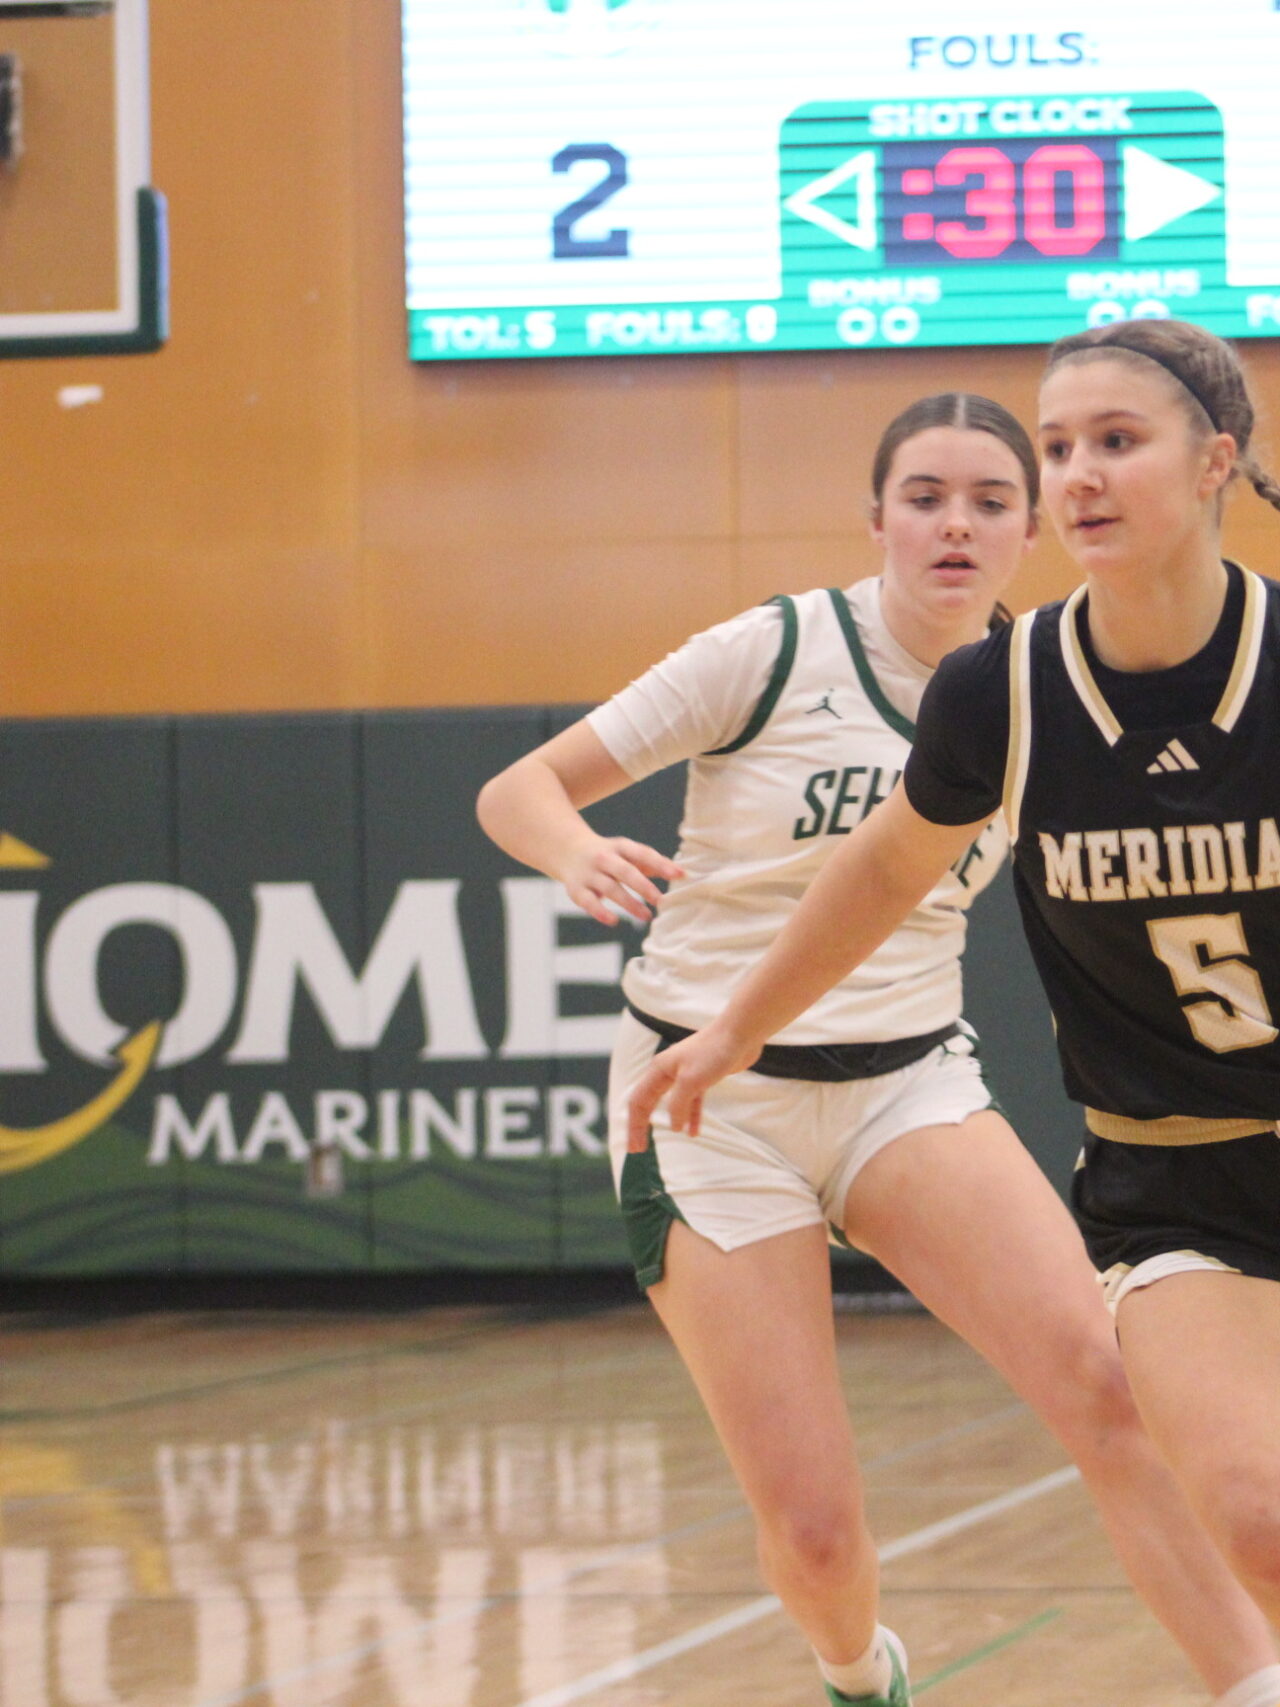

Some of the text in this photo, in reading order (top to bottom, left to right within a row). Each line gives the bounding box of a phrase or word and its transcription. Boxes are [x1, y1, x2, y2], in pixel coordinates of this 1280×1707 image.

[868, 98, 1133, 136] SHOT CLOCK
[551, 143, 628, 259] 2
[807, 276, 940, 308] BONUS
[1066, 269, 1199, 300] BONUS
[424, 314, 520, 351] TOL:
[585, 308, 741, 347] FOULS:
[1146, 912, 1279, 1054] 5
[146, 1084, 609, 1166] MARINER
